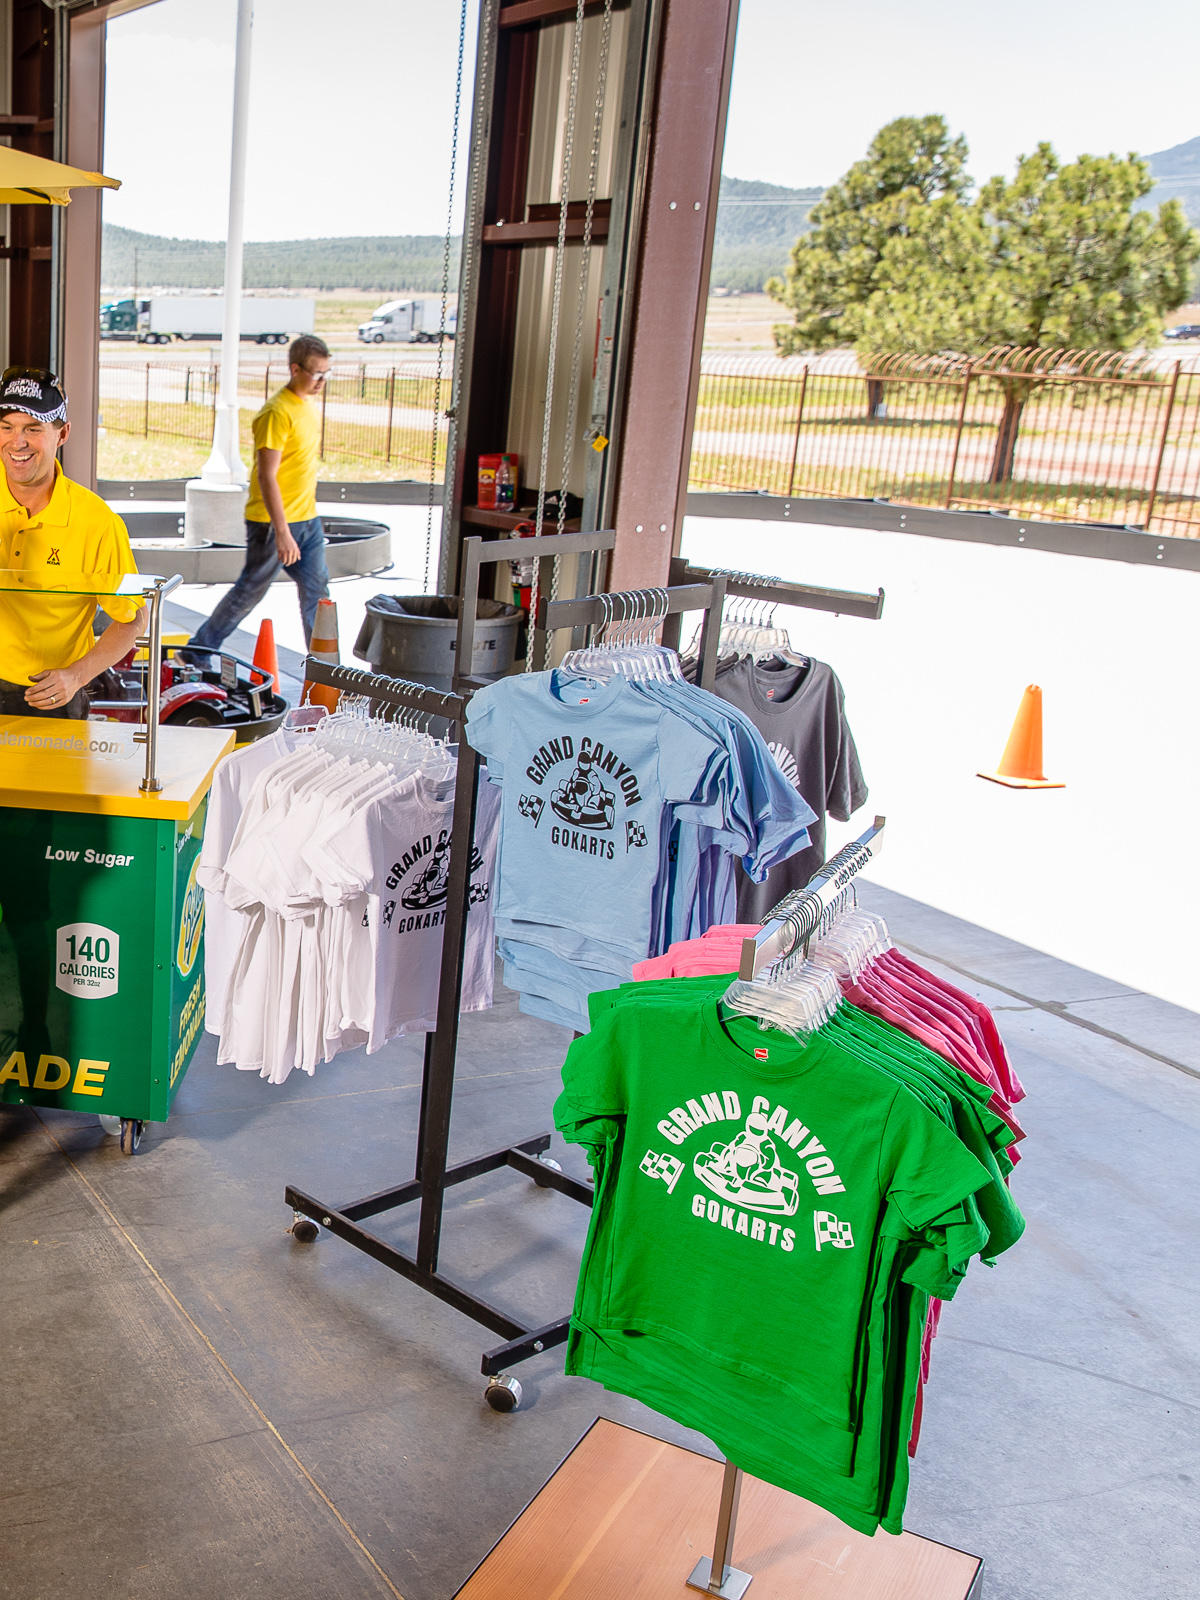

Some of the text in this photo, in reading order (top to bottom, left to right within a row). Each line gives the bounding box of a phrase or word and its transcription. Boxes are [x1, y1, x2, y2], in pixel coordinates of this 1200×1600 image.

[526, 735, 642, 807] GRAND CANYON
[45, 845, 134, 868] Low Sugar
[551, 826, 615, 860] GOKARTS
[385, 834, 433, 890] GRAND
[398, 910, 447, 934] GOKART
[65, 934, 110, 963] 140
[59, 962, 115, 979] CALORIES
[73, 977, 86, 986] PER
[179, 973, 202, 1039] FRESH
[656, 1090, 847, 1195] GRAND CANYON
[691, 1194, 797, 1252] GOKARTS
